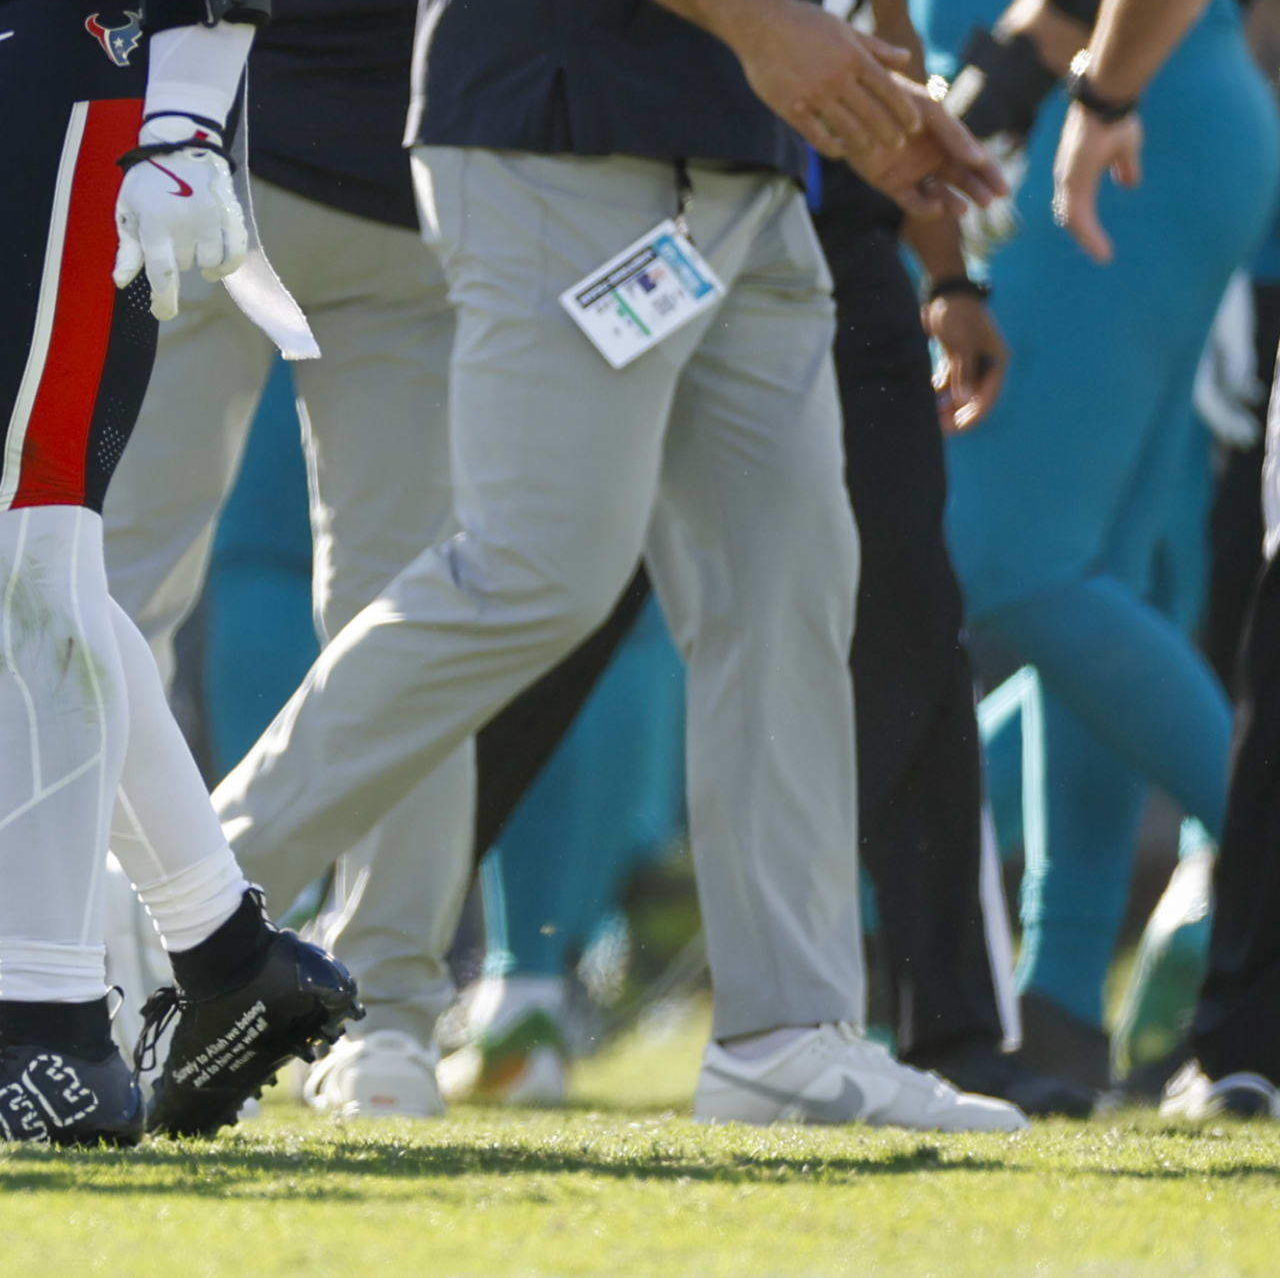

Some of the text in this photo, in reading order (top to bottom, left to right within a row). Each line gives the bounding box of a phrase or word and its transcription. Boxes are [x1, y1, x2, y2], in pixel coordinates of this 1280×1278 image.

[196, 1053, 208, 1064] to
[225, 1027, 240, 1041] we
[235, 1000, 266, 1030] belong
[206, 1064, 219, 1075] to
